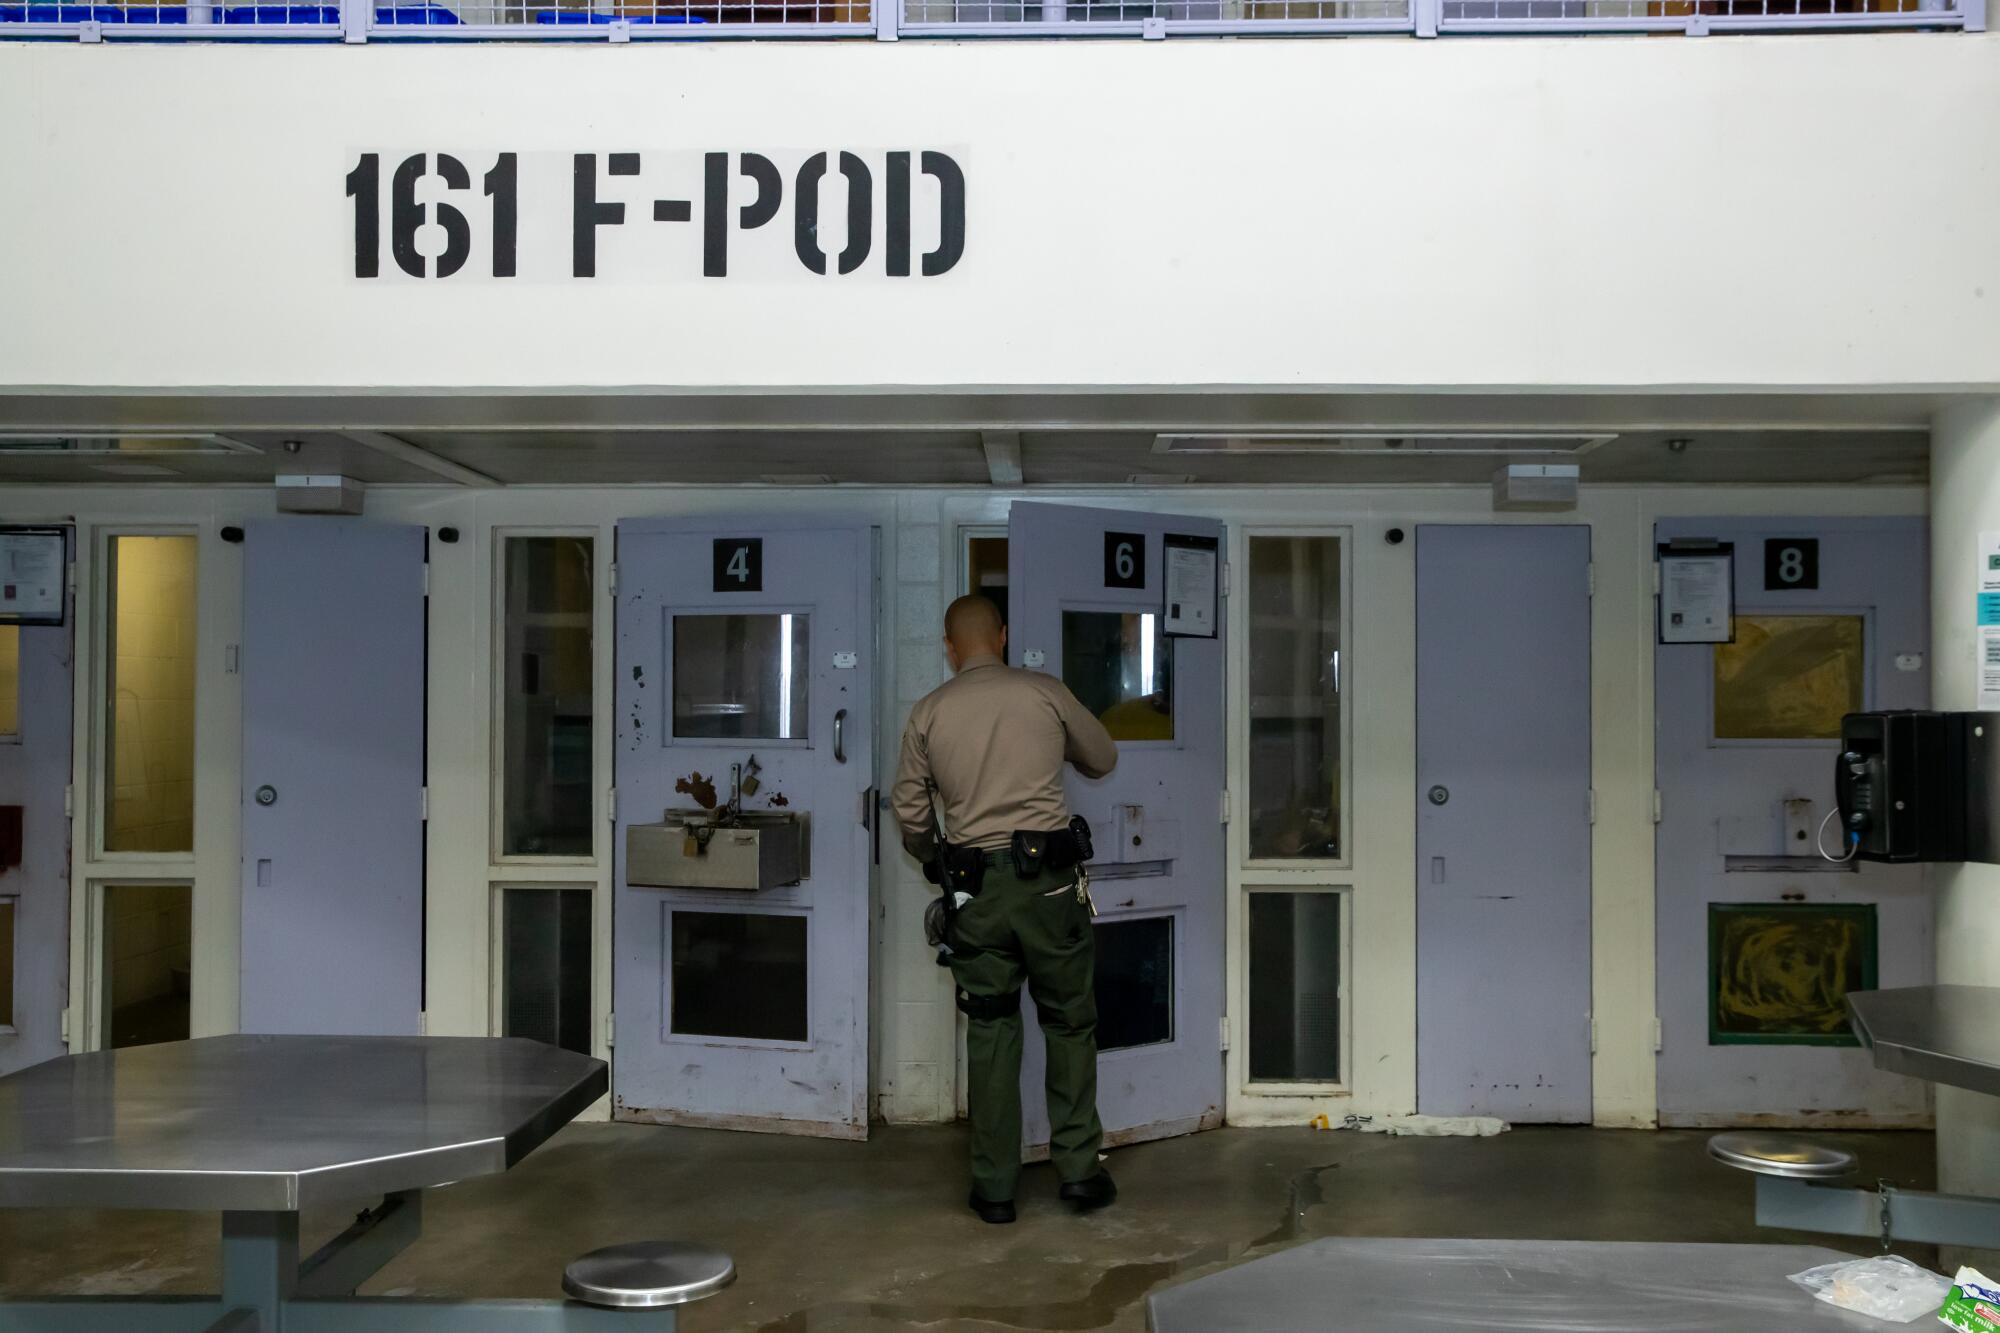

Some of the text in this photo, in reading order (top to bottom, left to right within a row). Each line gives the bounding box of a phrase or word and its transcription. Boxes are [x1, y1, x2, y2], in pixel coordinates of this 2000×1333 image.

[345, 150, 967, 279] 161 F-POD
[726, 547, 750, 583] 4
[1115, 542, 1135, 579] 6
[1779, 547, 1804, 583] 8
[1974, 1317, 1995, 1331] milk
